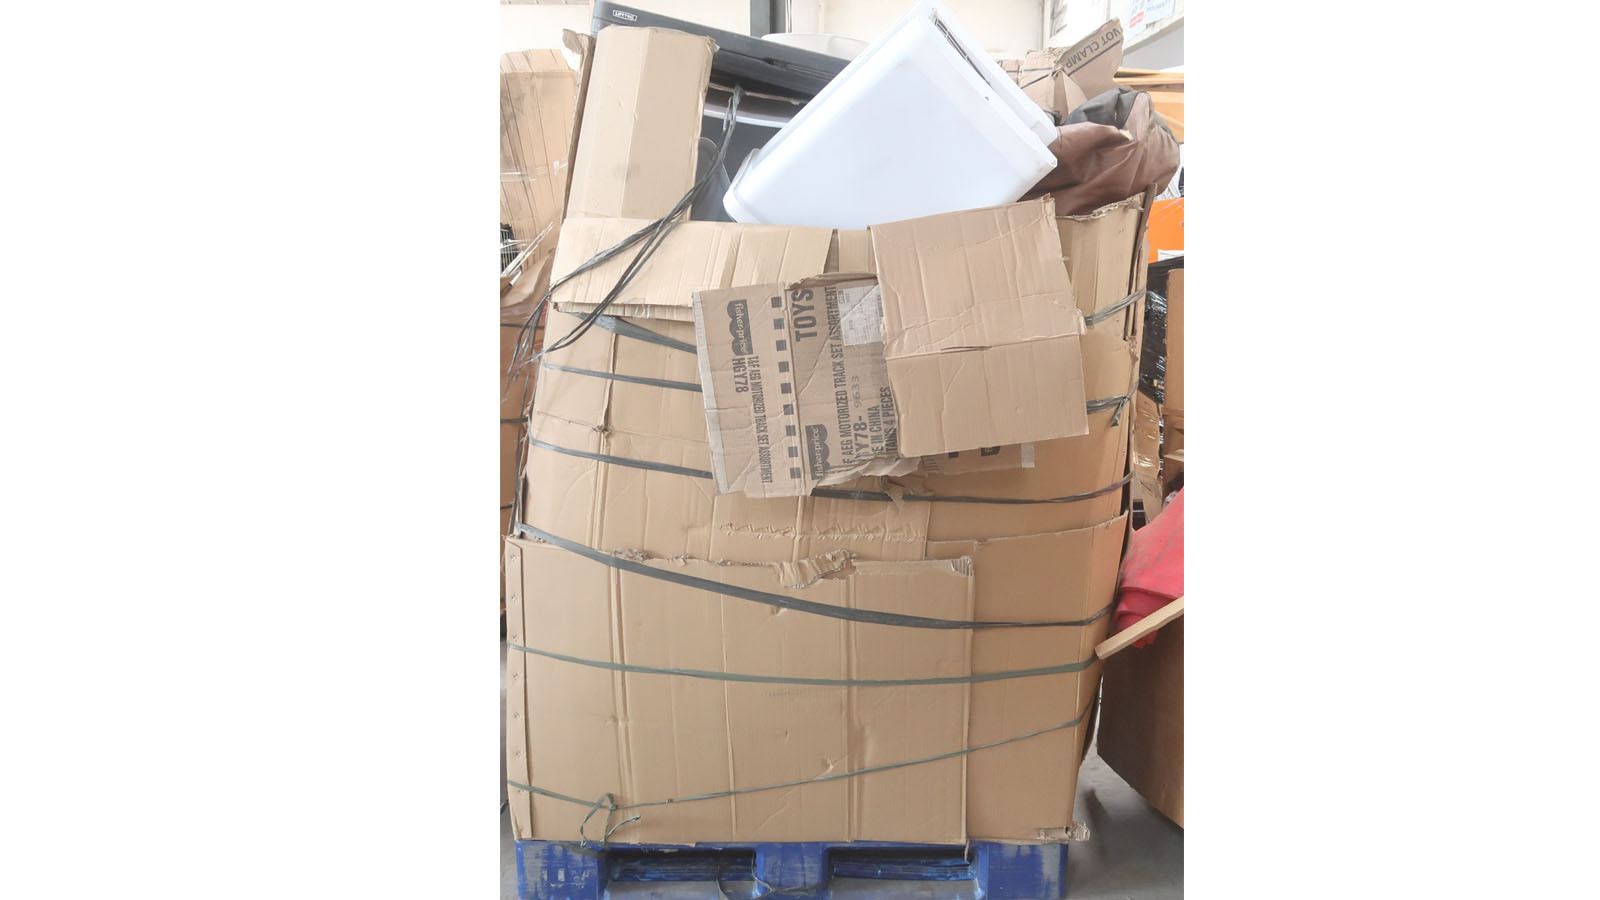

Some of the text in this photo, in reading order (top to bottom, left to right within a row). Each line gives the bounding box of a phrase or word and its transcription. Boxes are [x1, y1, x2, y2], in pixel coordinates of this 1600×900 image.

[1066, 42, 1100, 68] CLAMP
[735, 303, 749, 353] fisher-price
[791, 289, 818, 342] TOYS
[824, 286, 842, 340] ASSORTMENT
[830, 343, 844, 359] SET
[732, 357, 749, 393] HGY78
[831, 360, 847, 388] TRACK
[851, 375, 862, 408] 9633
[880, 386, 896, 418] PIECES
[747, 355, 773, 483] T&F AEG MOTORIZED TRACK SET ASSORTMENT
[835, 390, 852, 437] MOTORIZED
[867, 404, 882, 432] CHINA
[812, 427, 824, 476] fisher-price
[841, 439, 854, 456] AEG
[870, 434, 883, 444] IN
